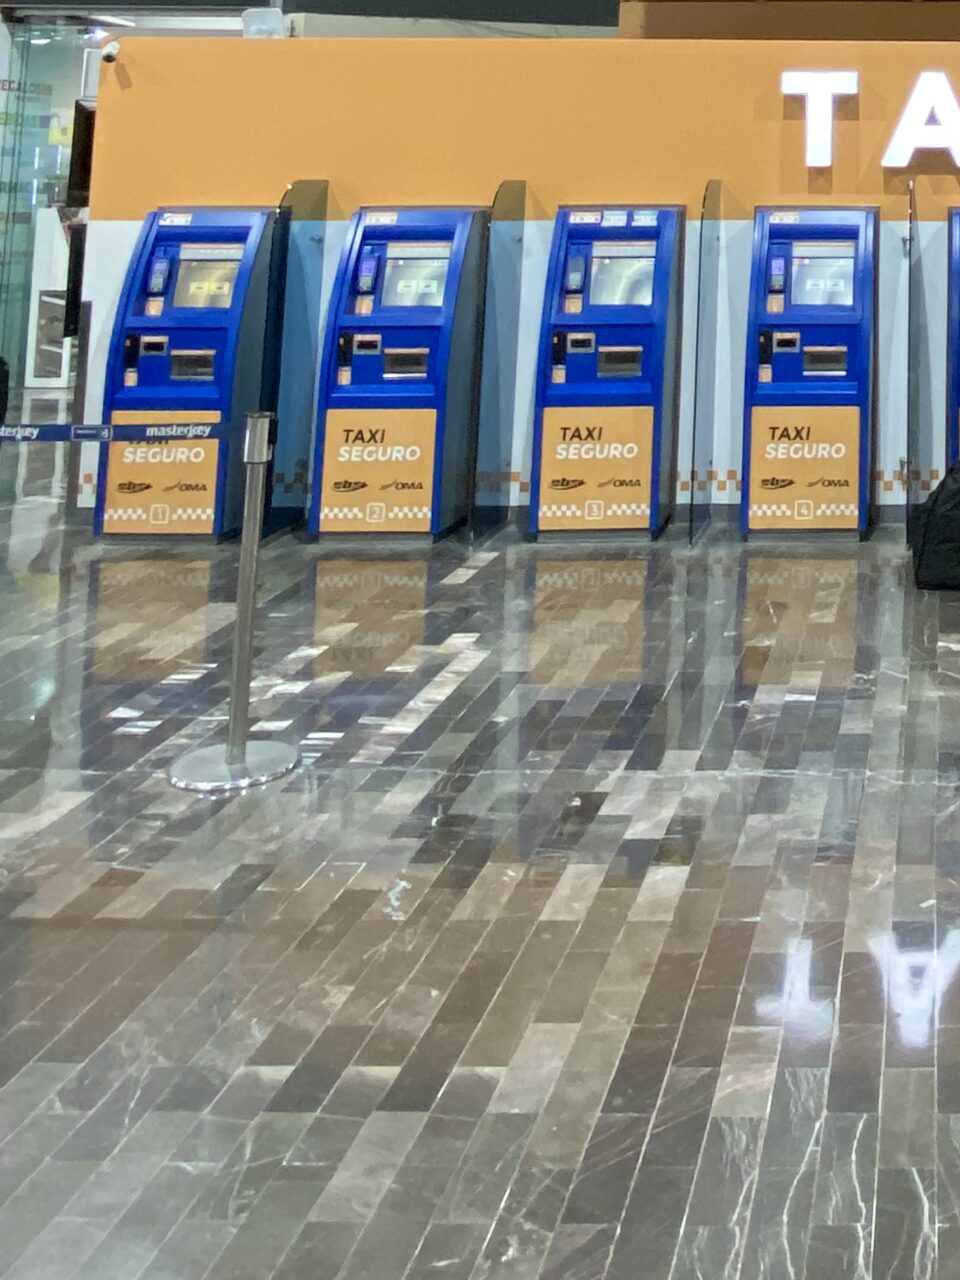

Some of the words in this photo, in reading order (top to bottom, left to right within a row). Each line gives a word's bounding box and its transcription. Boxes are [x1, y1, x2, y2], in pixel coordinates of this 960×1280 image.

[146, 424, 212, 438] masterkey
[343, 429, 386, 444] TAXI
[560, 426, 603, 441] TAXI
[769, 426, 811, 441] TAXI
[123, 447, 205, 464] SEGURO
[337, 445, 421, 462] SEGURO
[555, 443, 639, 460] SEGURO
[764, 443, 846, 459] SEGURO
[613, 479, 641, 488] OMA
[371, 507, 379, 519] 2
